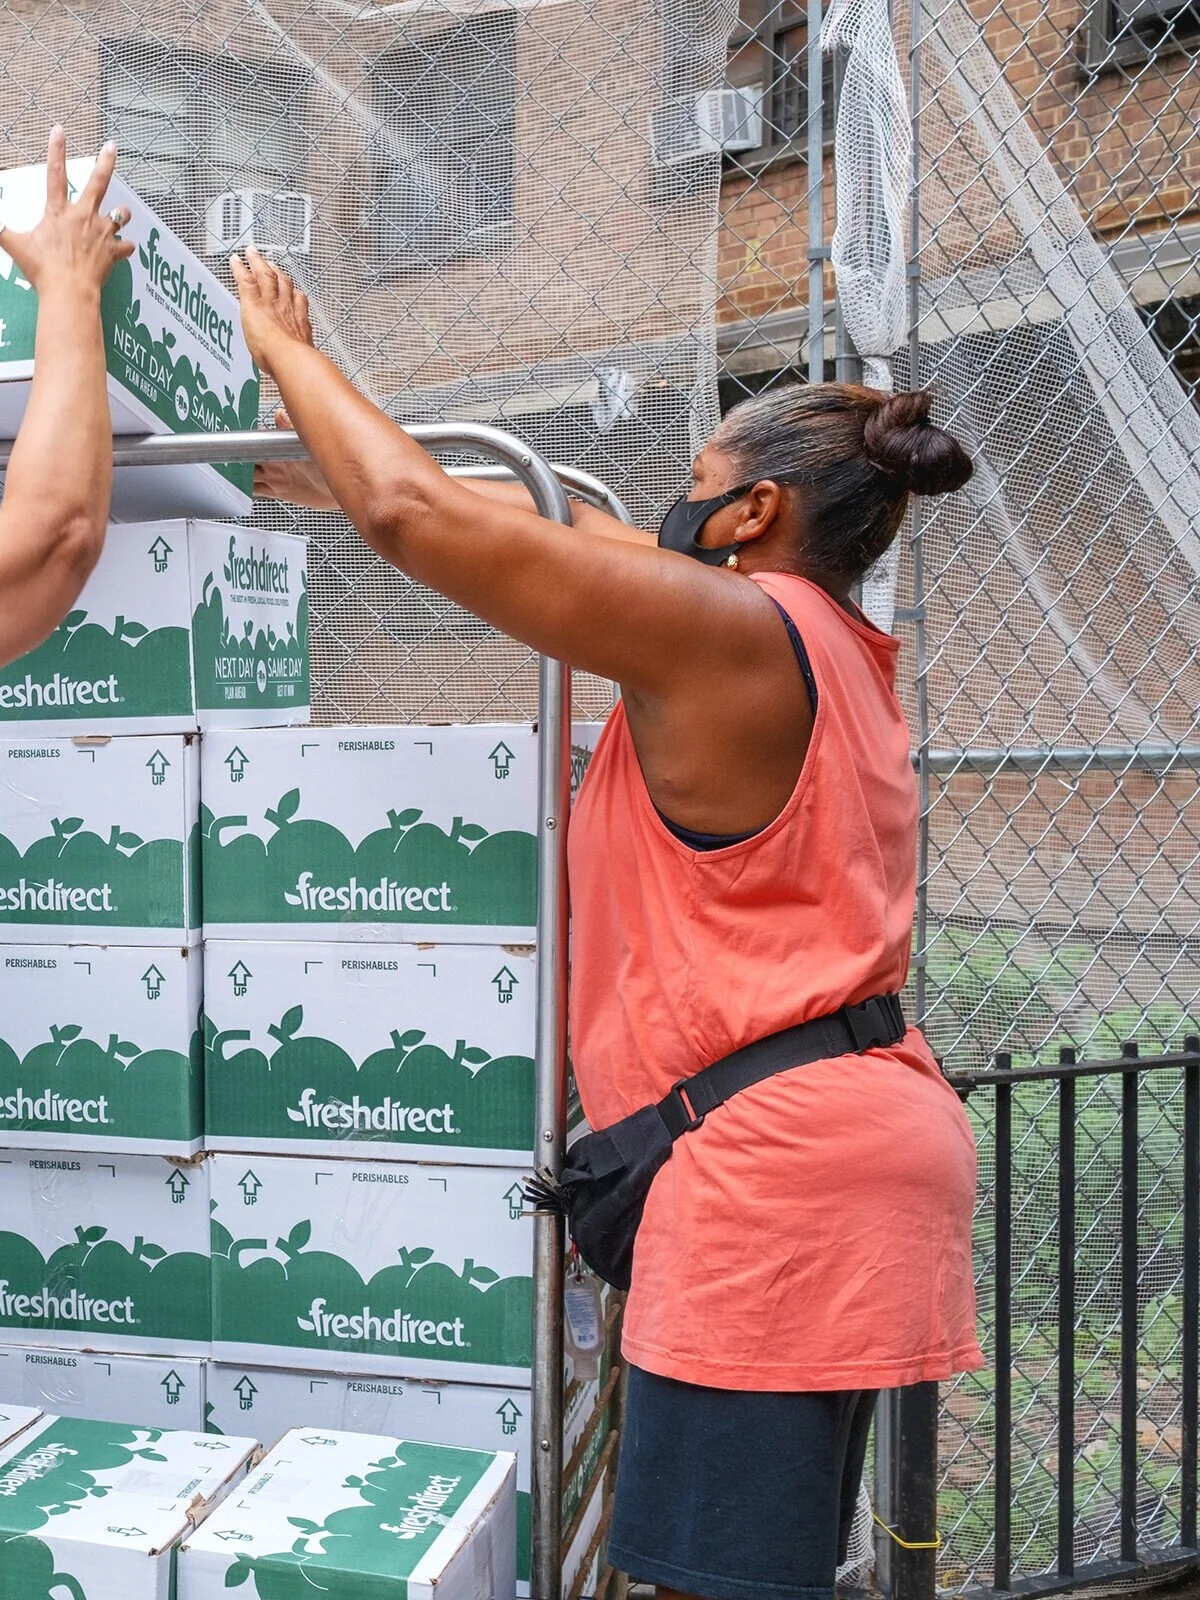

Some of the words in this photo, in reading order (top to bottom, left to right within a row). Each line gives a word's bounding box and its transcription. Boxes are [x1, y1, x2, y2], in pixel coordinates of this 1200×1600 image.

[147, 227, 234, 358] freshdirect
[114, 323, 147, 369] NEXT
[148, 355, 173, 392] DAY
[191, 395, 221, 432] SAME
[154, 562, 168, 573] UP
[228, 535, 289, 594] freshdirect
[214, 657, 237, 679] NEXT
[238, 657, 255, 678] DAY
[267, 657, 287, 678] SAME
[288, 657, 303, 677] DAY
[338, 741, 395, 751] PERISHABLES
[8, 749, 60, 759] PERISHABLES
[230, 773, 244, 783] UP
[495, 769, 509, 780] UP
[152, 776, 165, 786] UP
[295, 871, 452, 911] freshdirect
[5, 958, 57, 969] PERISHABLES
[341, 960, 399, 971] PERISHABLES
[147, 991, 161, 1000] UP
[233, 986, 247, 997] UP
[498, 993, 513, 1004] UP
[298, 1088, 455, 1134] freshdirect
[29, 1160, 81, 1171] PERISHABLES
[352, 1172, 409, 1184] PERISHABLES
[172, 1193, 185, 1204] UP
[244, 1195, 257, 1206] UP
[509, 1209, 522, 1220] UP
[308, 1297, 465, 1347] freshdirect
[25, 1354, 77, 1367] PERISHABLES
[346, 1382, 403, 1396] PERISHABLES
[167, 1394, 180, 1405] UP
[240, 1401, 253, 1411] UP
[502, 1425, 517, 1436] UP
[379, 1475, 458, 1535] freshdirect
